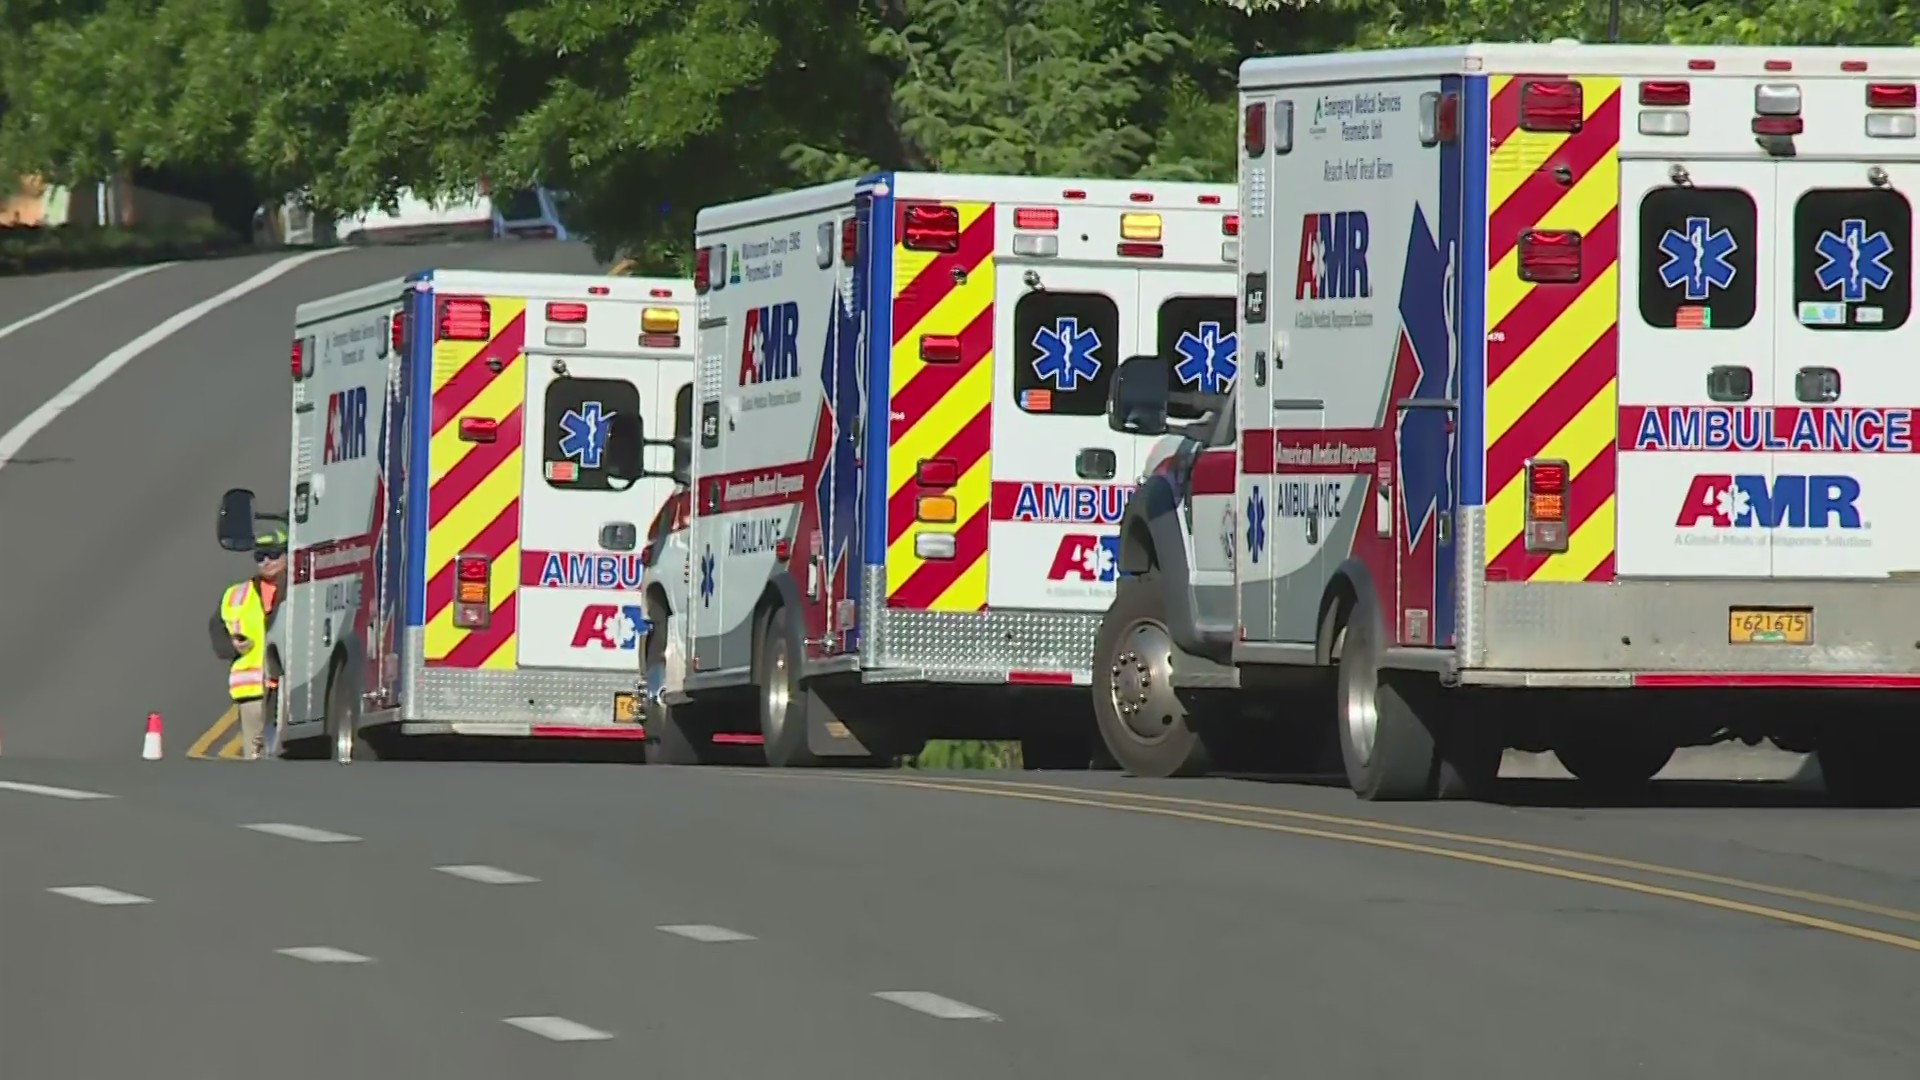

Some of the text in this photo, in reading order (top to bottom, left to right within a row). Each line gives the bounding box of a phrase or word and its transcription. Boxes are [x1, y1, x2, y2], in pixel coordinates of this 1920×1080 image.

[1295, 210, 1370, 300] AMR
[739, 301, 799, 387] AMR
[323, 386, 367, 465] AMR
[1635, 408, 1912, 450] AMBULANCE
[1013, 483, 1134, 524] AMBU
[1675, 474, 1862, 529] AMR
